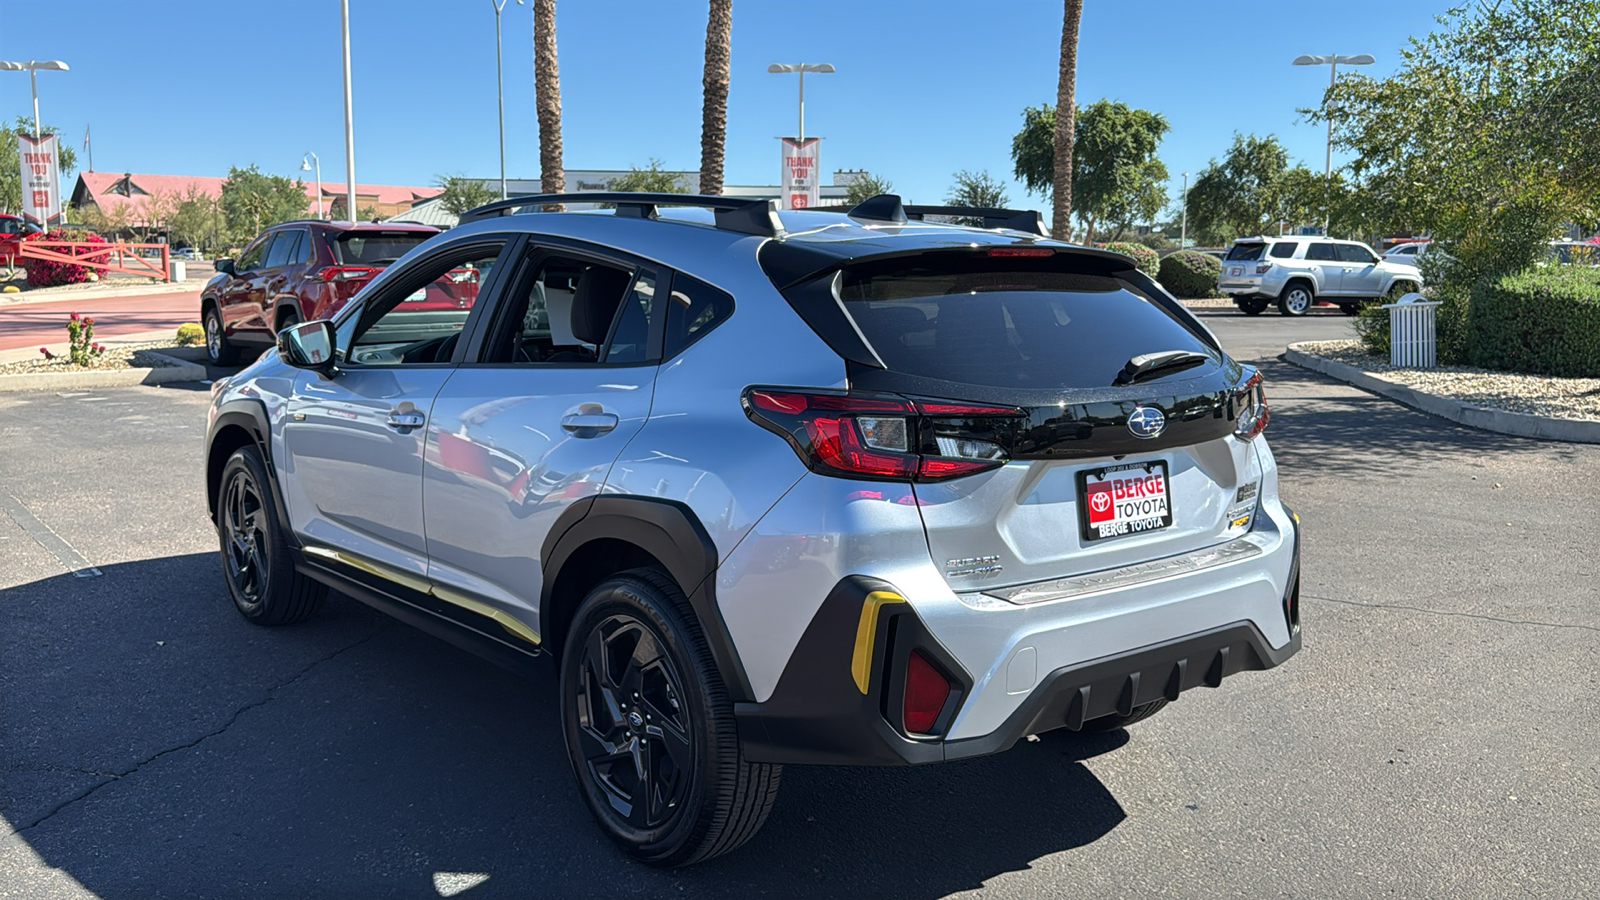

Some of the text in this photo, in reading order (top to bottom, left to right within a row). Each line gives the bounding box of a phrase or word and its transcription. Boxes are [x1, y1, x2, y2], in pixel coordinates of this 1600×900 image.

[24, 153, 52, 164] THANK
[786, 156, 814, 168] THANK
[30, 164, 47, 175] YOU
[791, 168, 808, 179] YOU
[1113, 474, 1164, 500] BERGE
[1116, 498, 1167, 519] TOYOTA
[1099, 516, 1164, 538] BERGE TOYOTA
[621, 590, 671, 633] FALKEN
